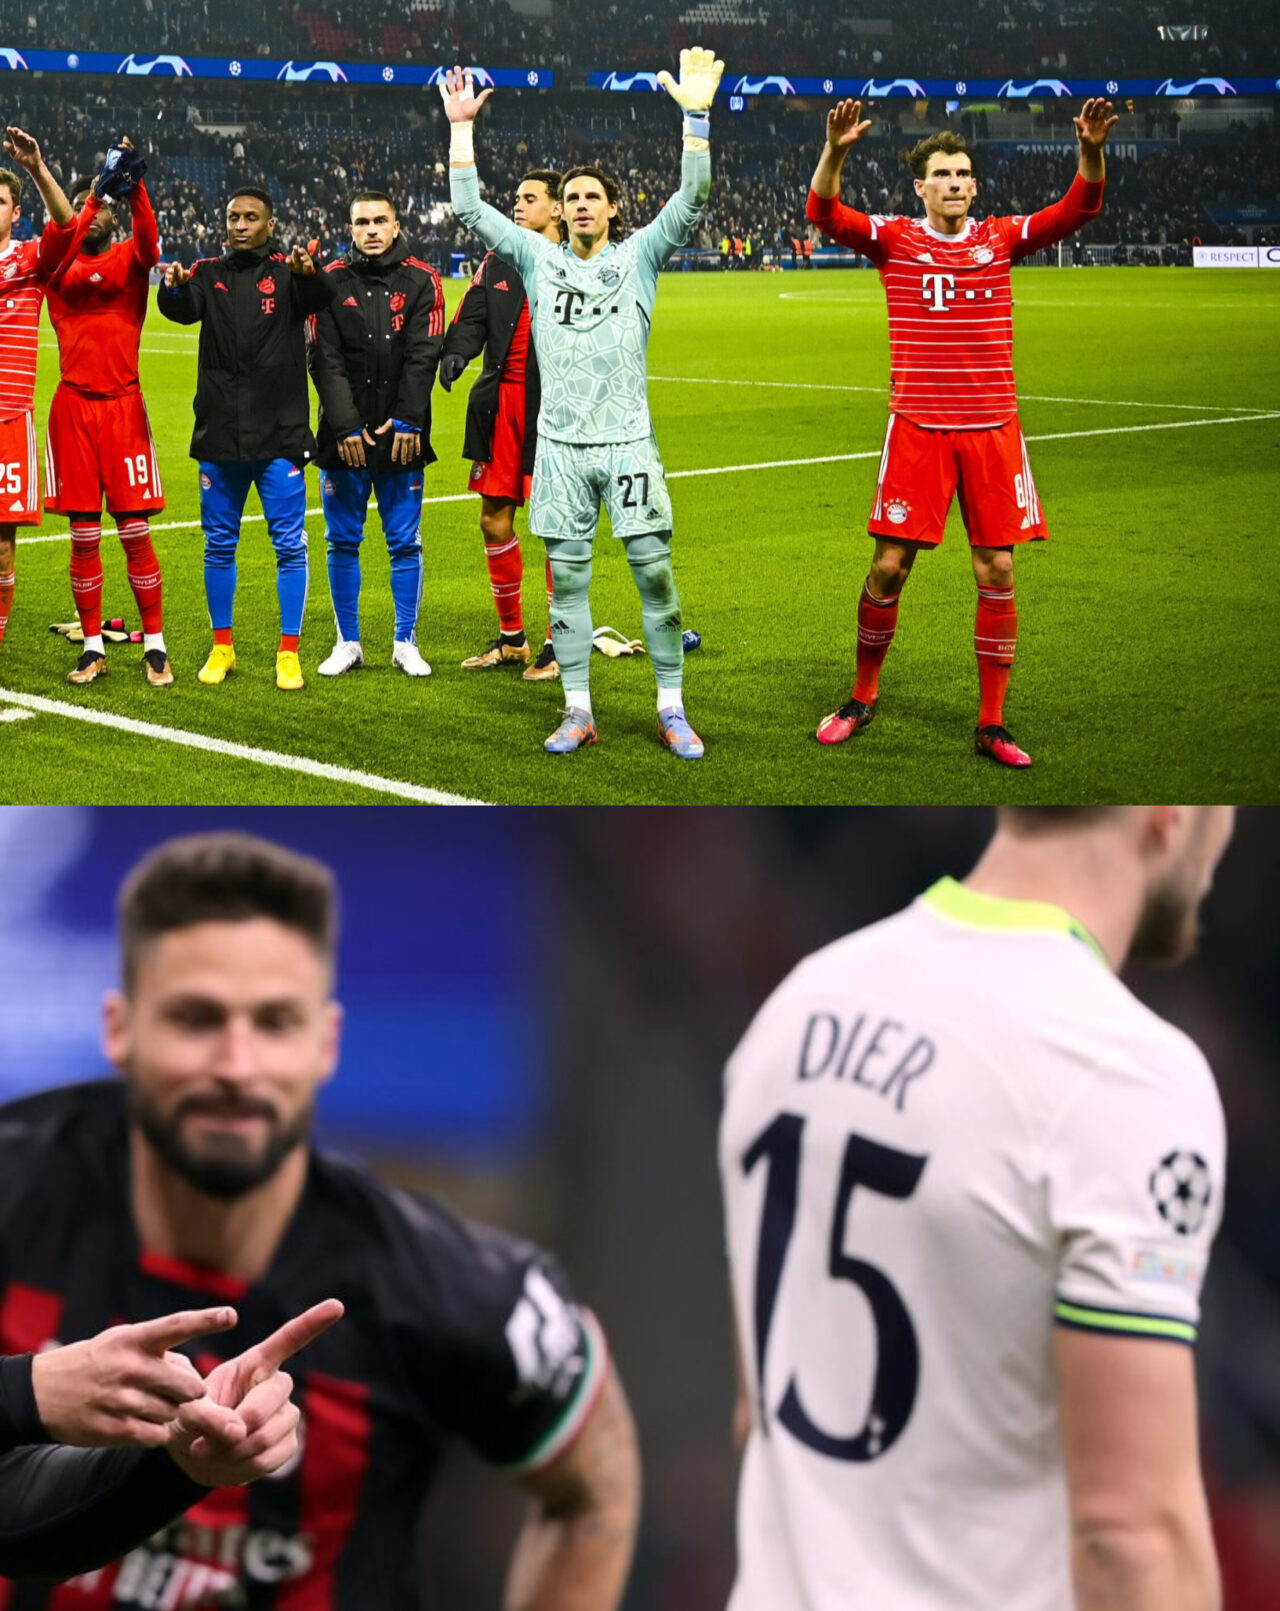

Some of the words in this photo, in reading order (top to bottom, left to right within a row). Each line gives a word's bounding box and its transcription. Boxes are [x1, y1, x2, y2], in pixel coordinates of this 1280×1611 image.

[1210, 252, 1255, 262] RESPECT
[124, 454, 149, 487] 19
[618, 473, 649, 508] 27
[1014, 473, 1026, 508] 8
[796, 1010, 936, 1113] DIER
[740, 1111, 930, 1464] 15
